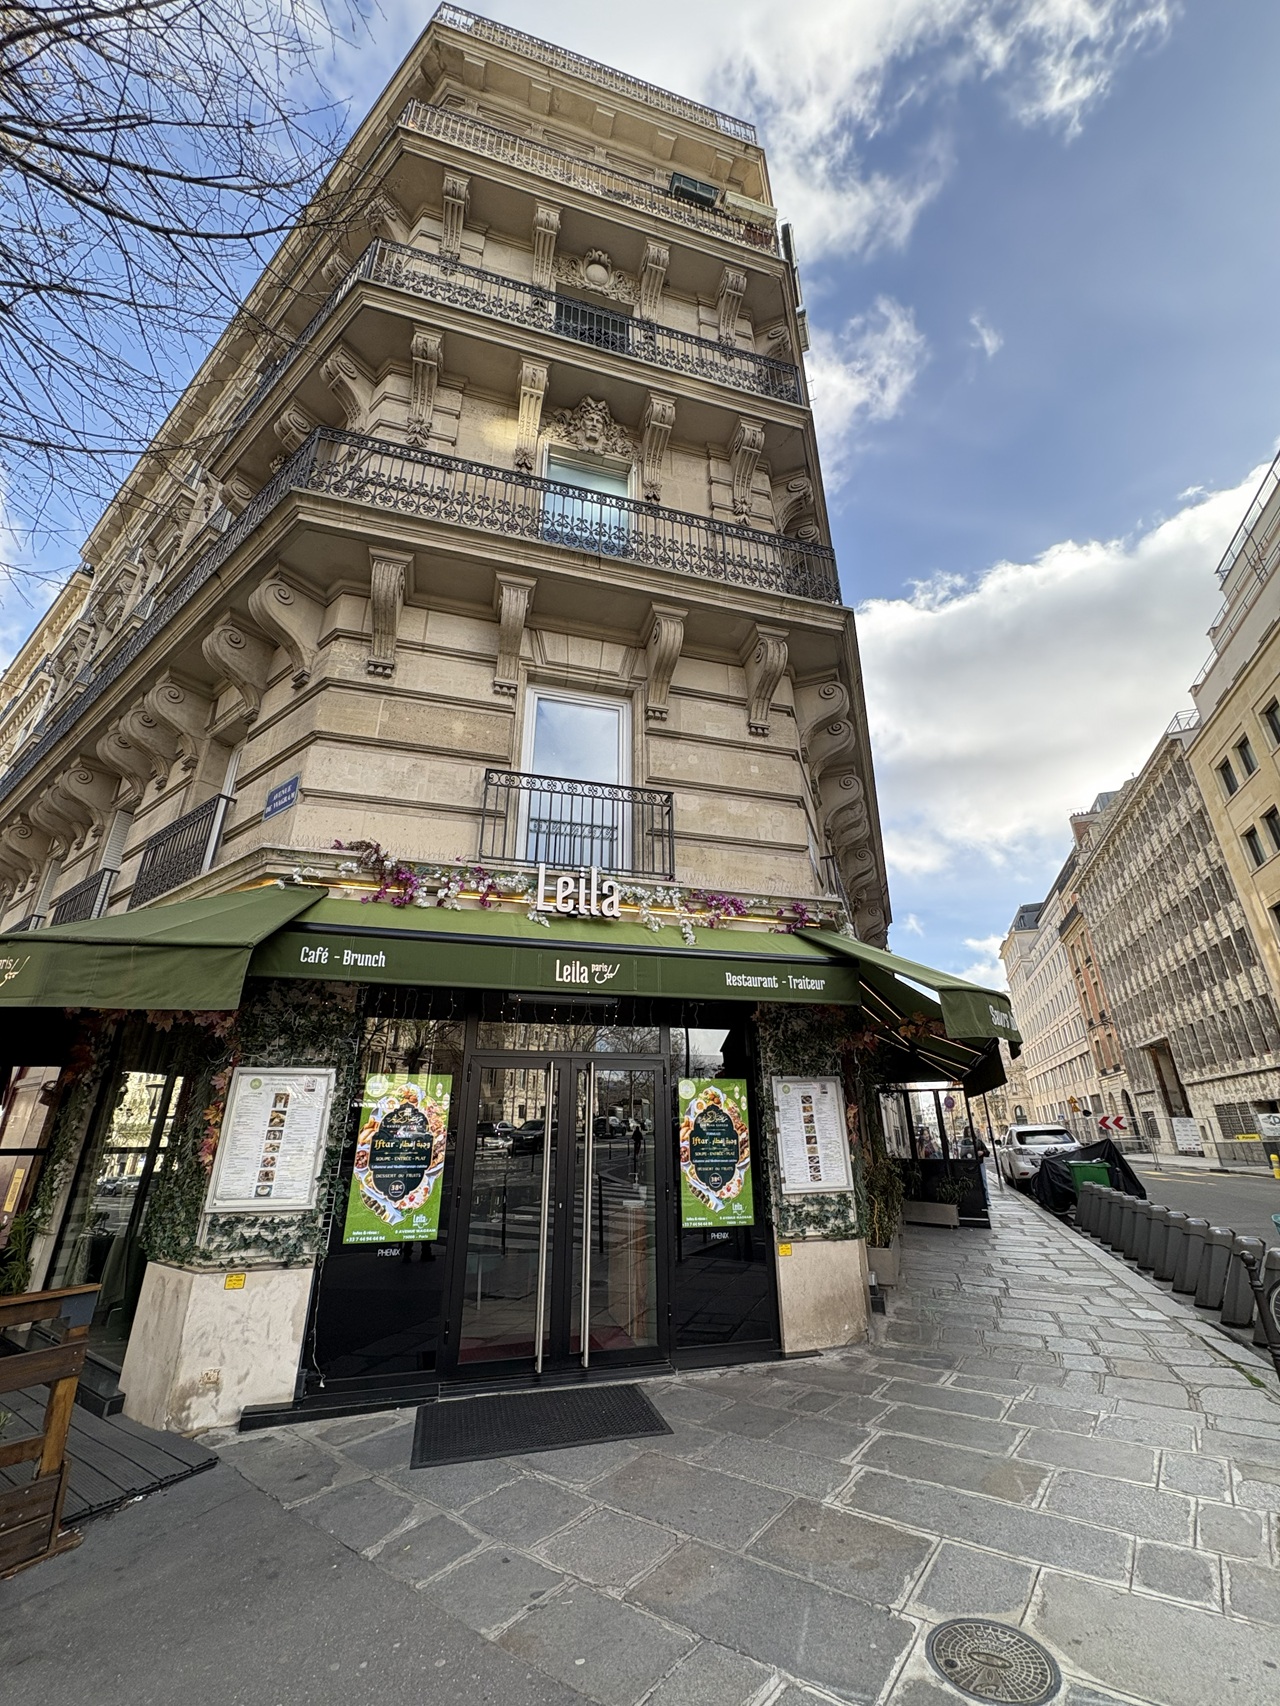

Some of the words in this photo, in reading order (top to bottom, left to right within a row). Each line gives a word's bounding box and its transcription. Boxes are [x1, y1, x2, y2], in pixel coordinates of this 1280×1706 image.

[537, 863, 621, 917] Leila
[300, 946, 329, 964] Café
[342, 949, 386, 967] Brunch
[556, 959, 589, 983] Leila
[591, 963, 608, 973] paris
[725, 972, 778, 988] Restaurant
[788, 975, 825, 990] Traiteur
[374, 1139, 395, 1150] Iftar
[692, 1137, 708, 1146] Iftar
[413, 1214, 426, 1223] Leila
[377, 1249, 401, 1257] PHENIX
